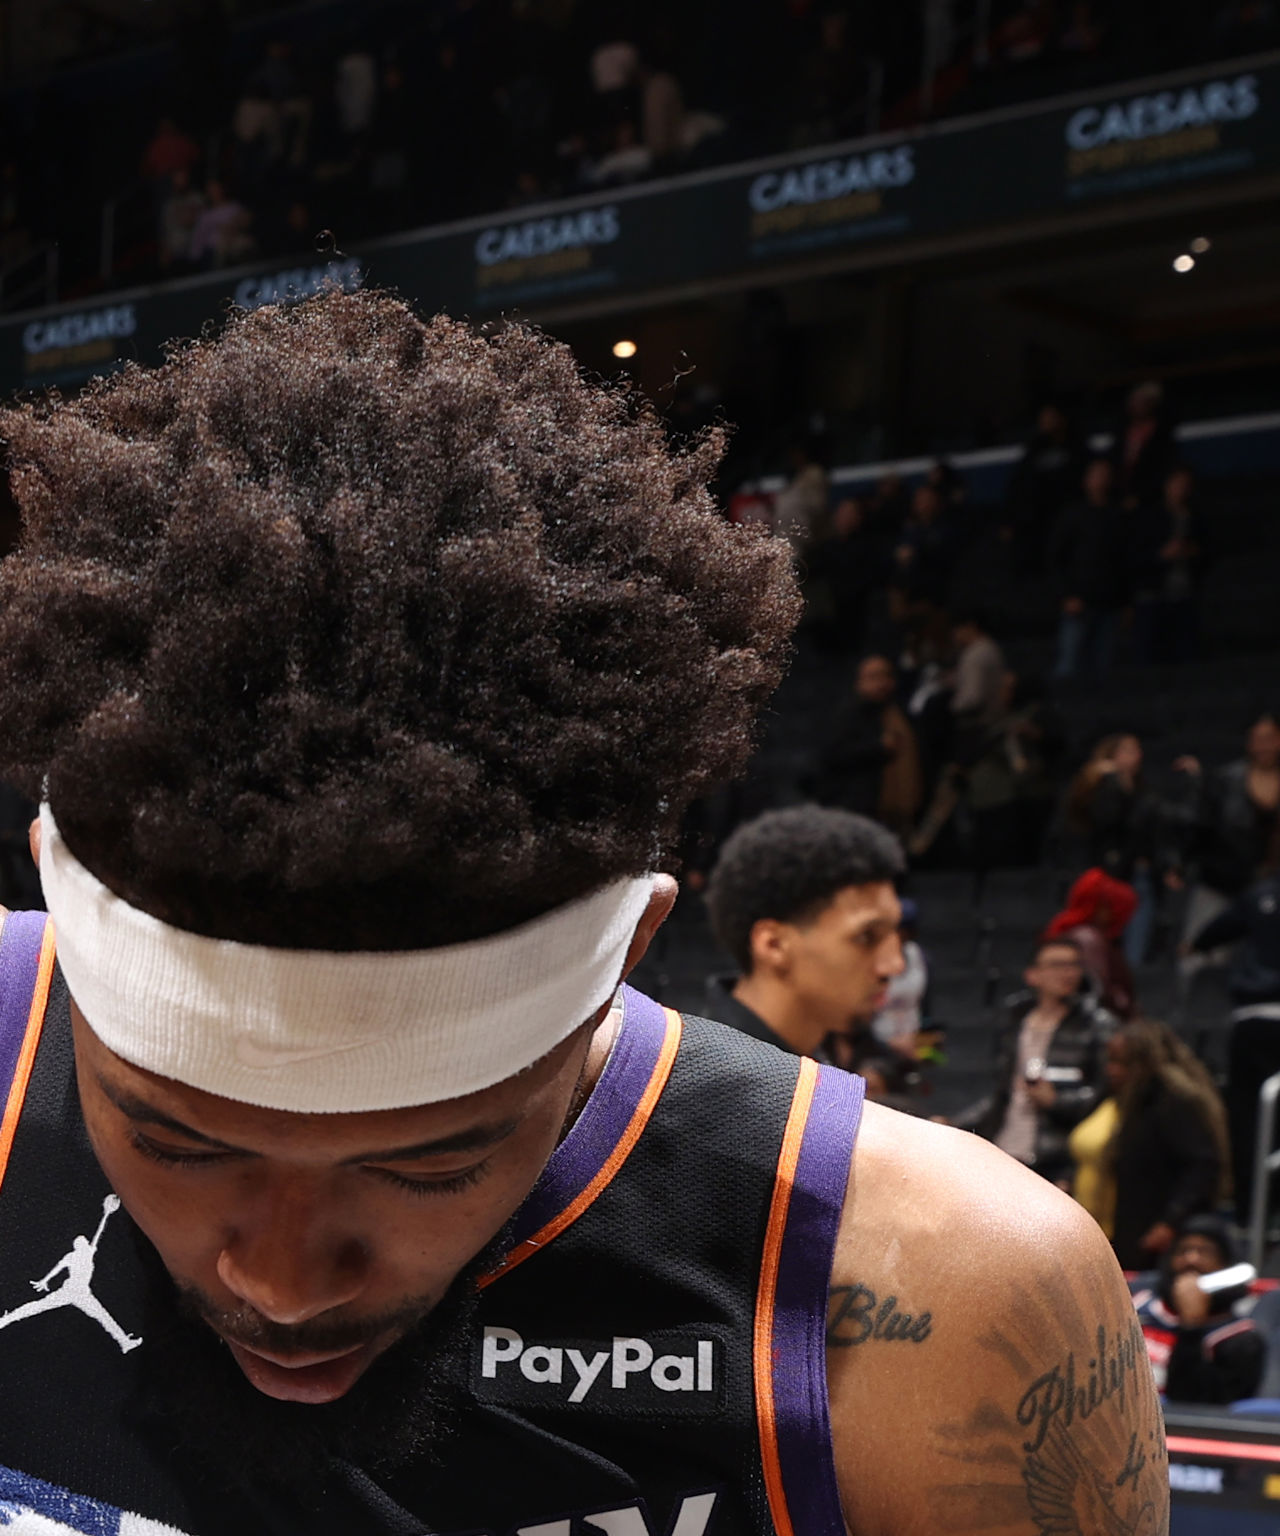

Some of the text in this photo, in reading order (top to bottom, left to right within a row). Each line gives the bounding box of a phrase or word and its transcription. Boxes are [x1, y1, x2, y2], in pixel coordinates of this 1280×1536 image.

[1065, 73, 1261, 151] CAESARS
[749, 144, 915, 214] CAESARS
[474, 204, 620, 266] CAESARS
[22, 304, 137, 355] CAESARS
[482, 1325, 713, 1403] PayPal
